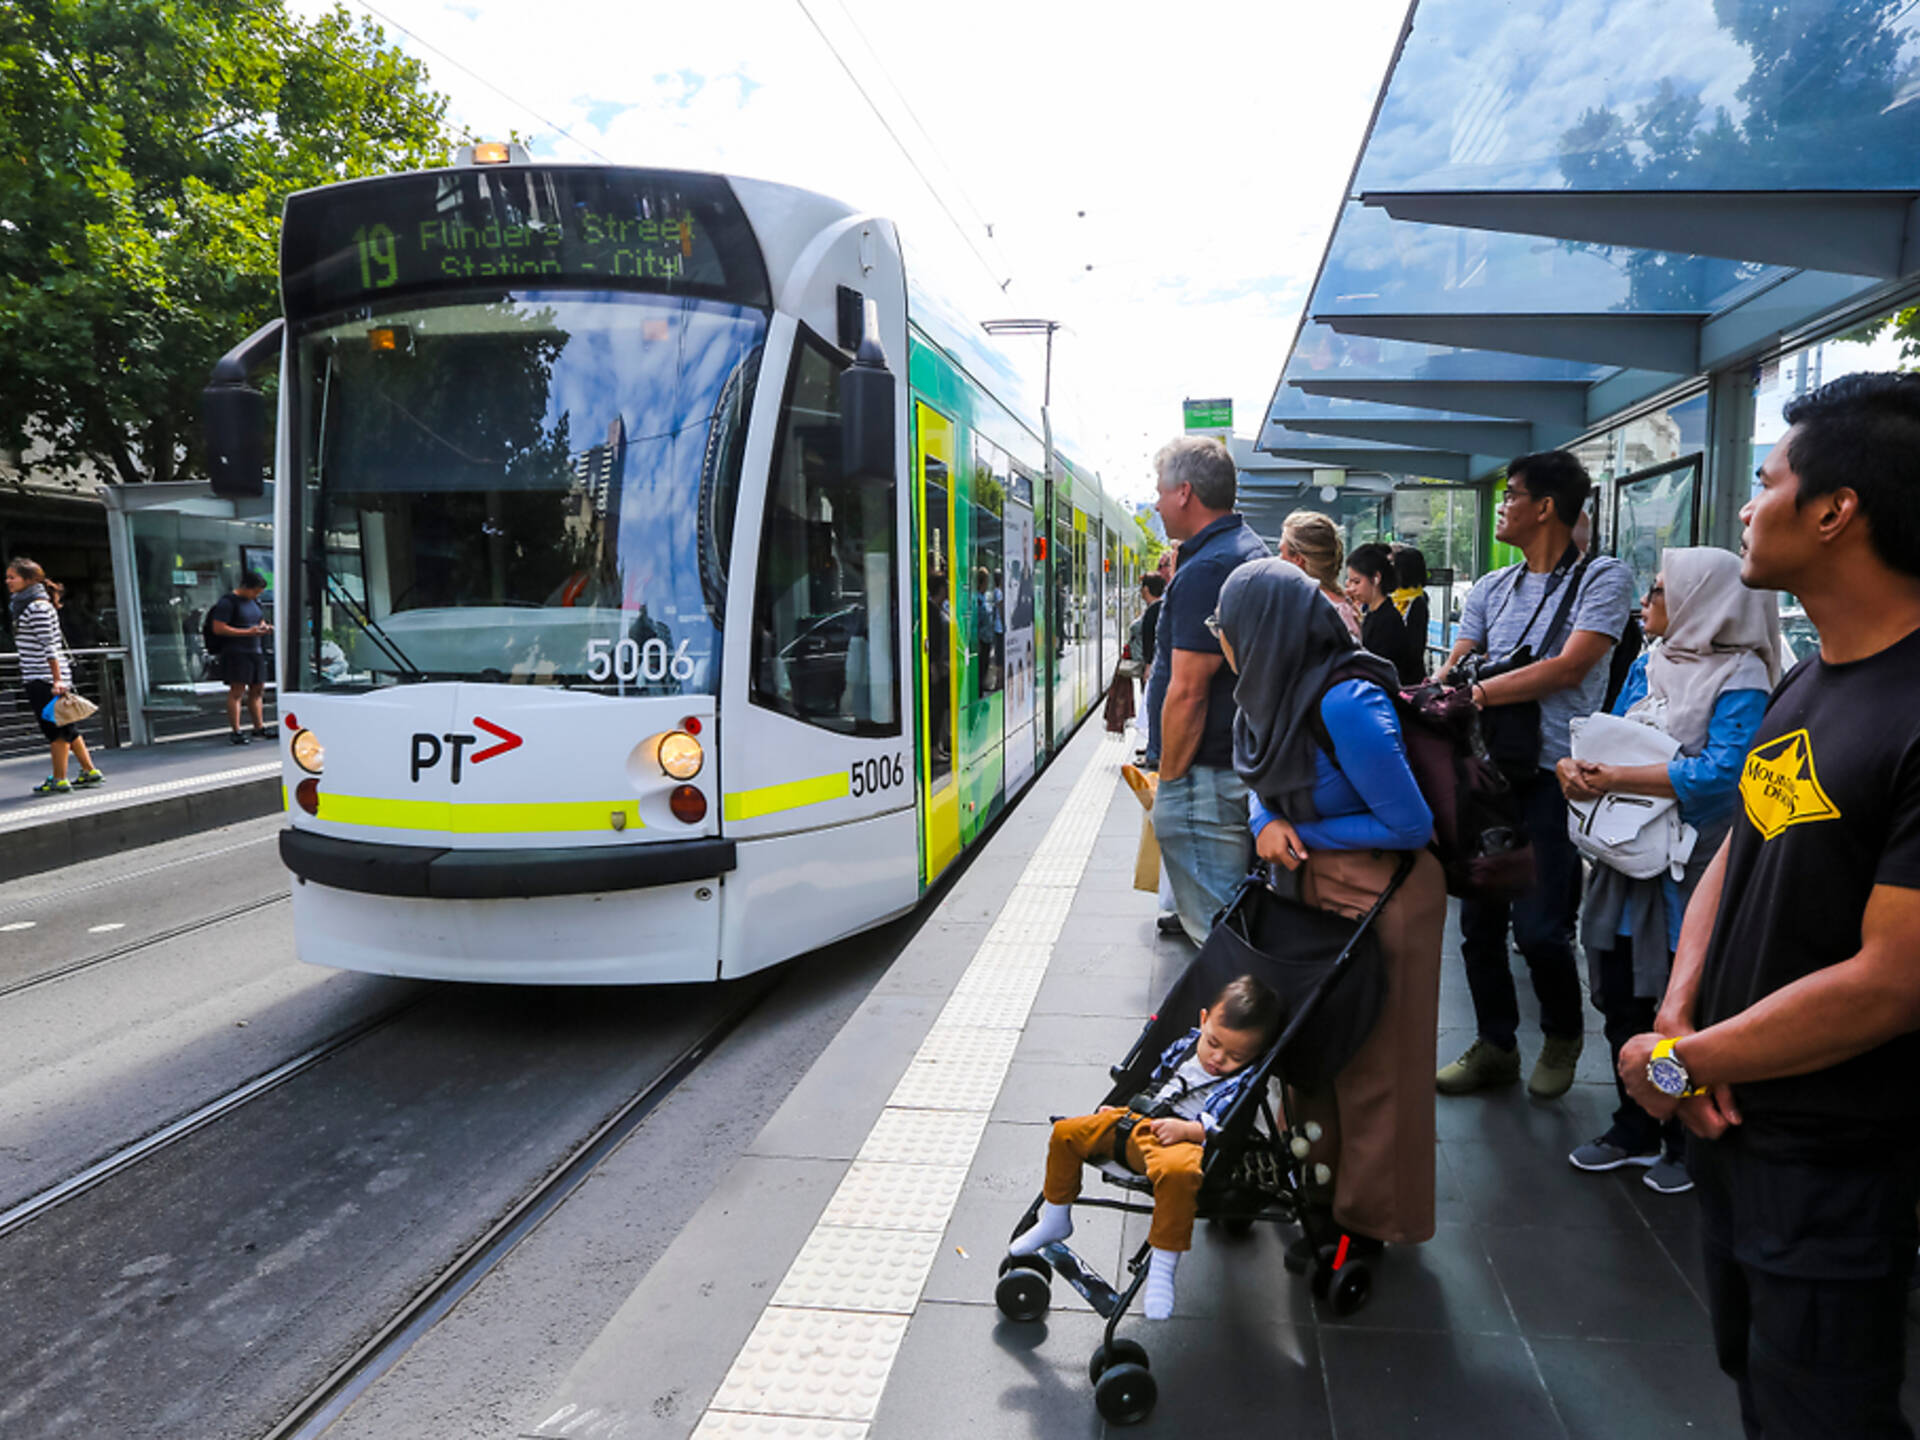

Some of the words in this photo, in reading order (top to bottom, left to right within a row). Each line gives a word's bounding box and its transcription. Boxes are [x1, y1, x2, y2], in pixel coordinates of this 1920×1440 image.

[420, 216, 563, 250] Flinders
[583, 210, 696, 243] Street
[352, 223, 399, 288] 19
[587, 638, 695, 681] 5006
[851, 752, 904, 798] 5006
